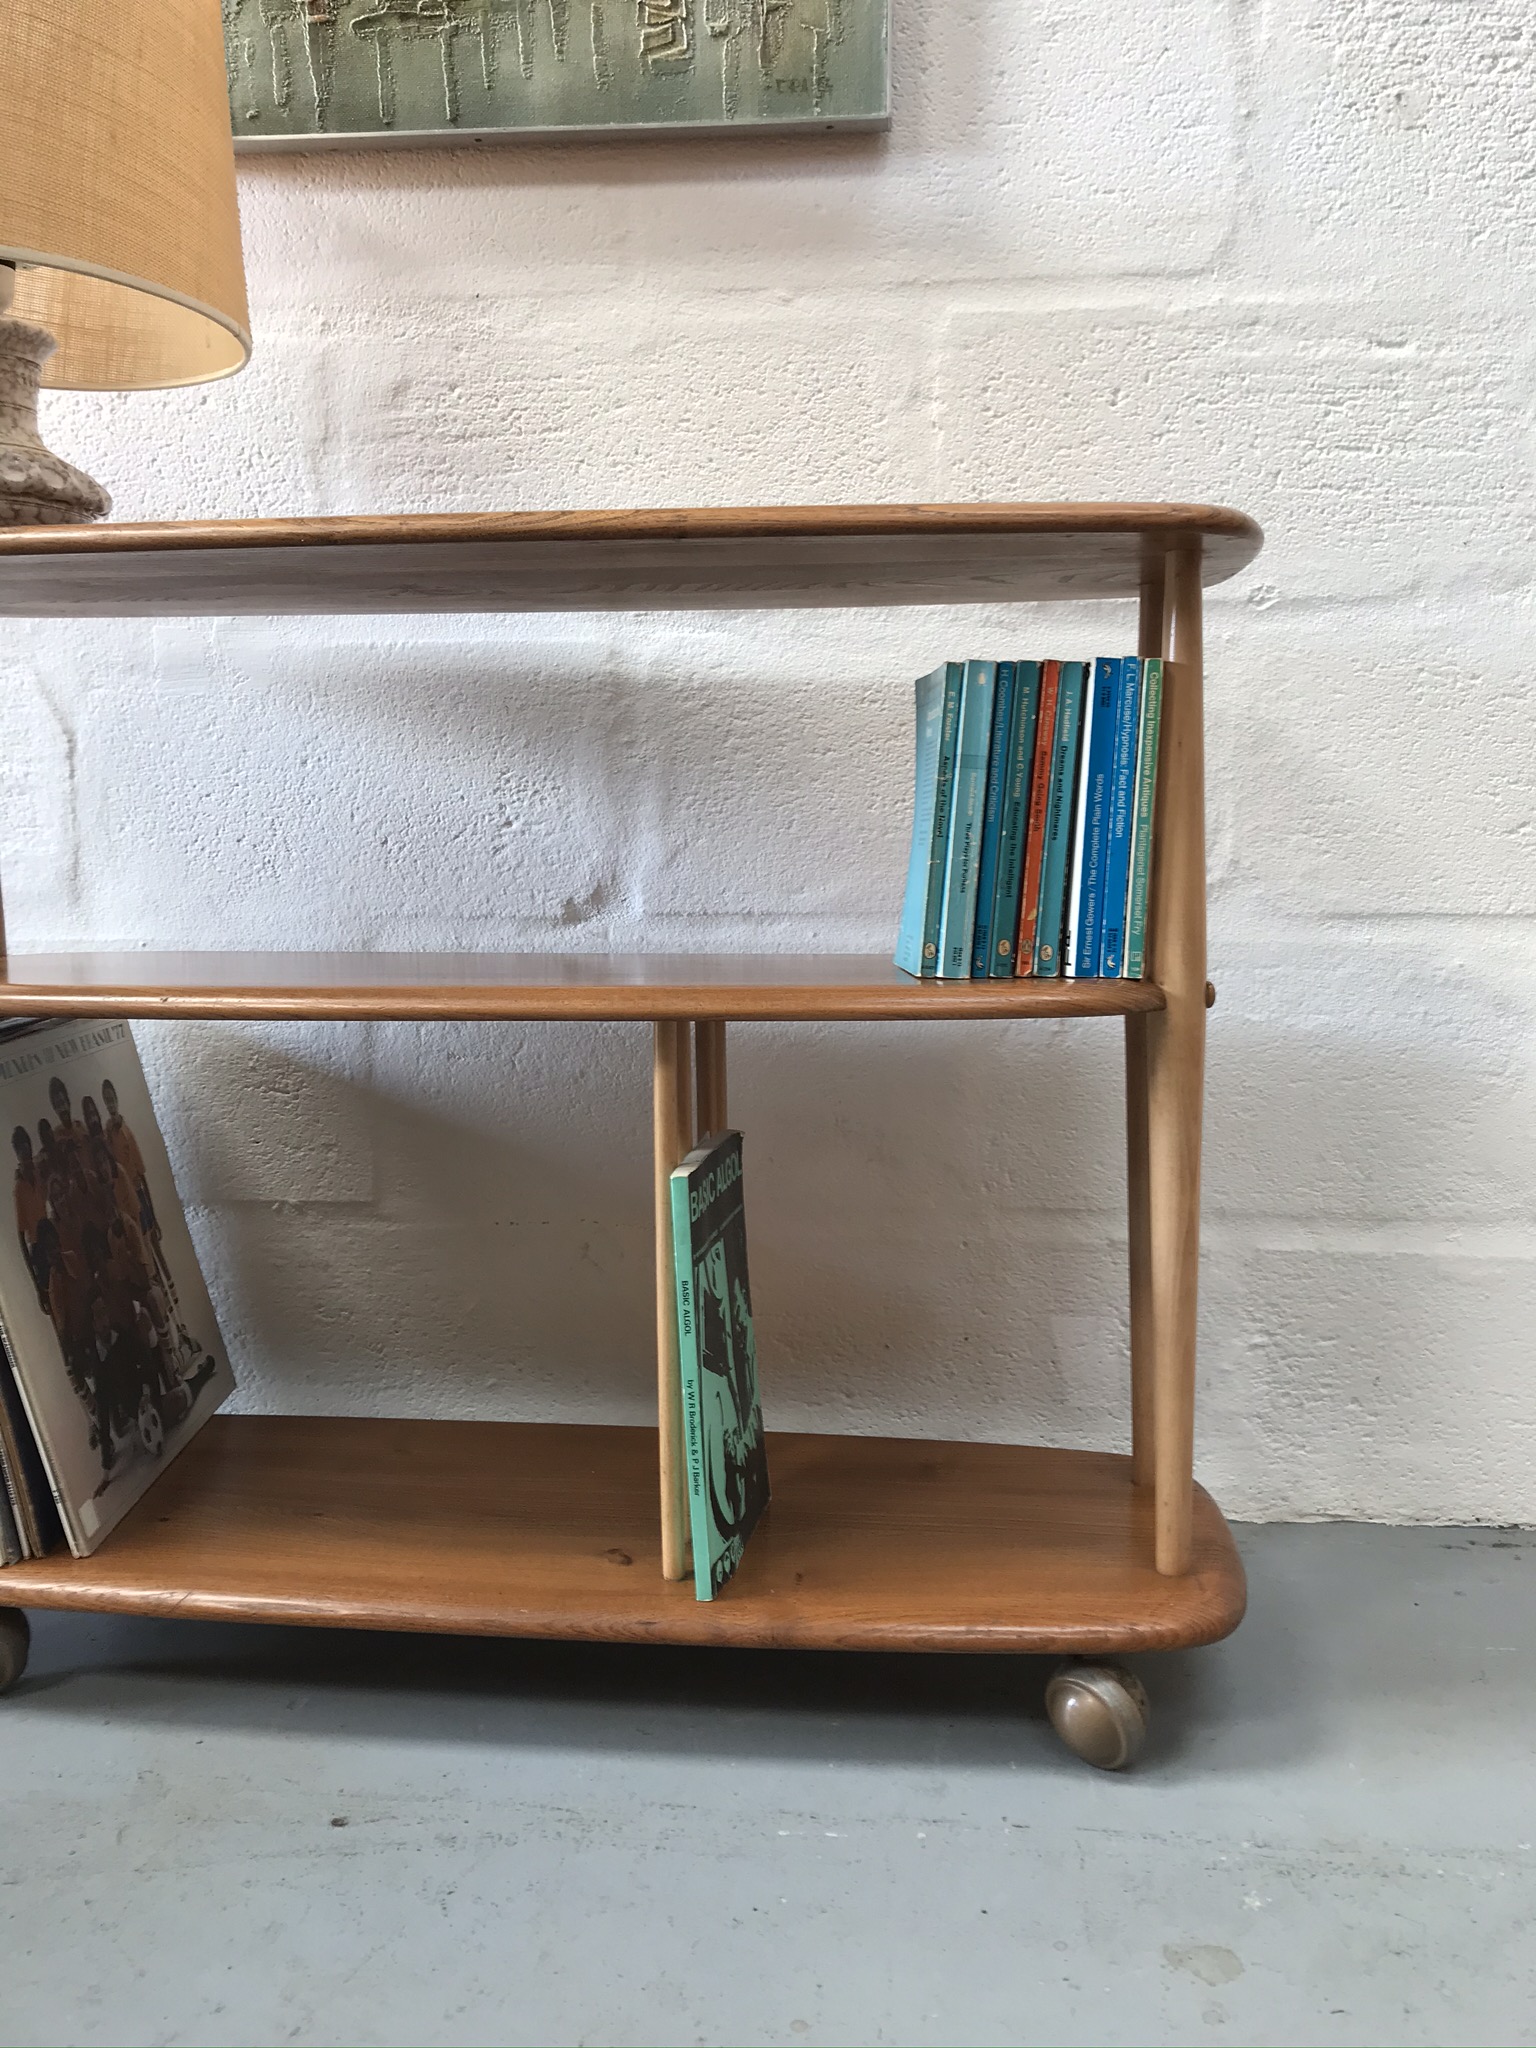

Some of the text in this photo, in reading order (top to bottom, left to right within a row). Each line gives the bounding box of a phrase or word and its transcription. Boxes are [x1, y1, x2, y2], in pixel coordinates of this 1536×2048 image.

[1017, 697, 1029, 743] Hutchinson
[1061, 708, 1072, 742] Hadfield
[1017, 745, 1025, 761] and
[1058, 745, 1068, 776] Dreams
[990, 768, 1001, 784] and
[1056, 778, 1065, 793] and
[1093, 773, 1104, 802] Words
[1118, 769, 1128, 789] Fact
[939, 789, 947, 798] of
[939, 800, 947, 813] the
[987, 785, 999, 823] Criticism
[1035, 783, 1045, 806] Going
[1117, 790, 1127, 807] and
[1131, 672, 1159, 935] Collecting Inexpensive Antiques Plantagenet Somerset Fry
[936, 815, 946, 838] Novel
[1009, 801, 1019, 841] Educating
[1051, 795, 1063, 841] Nightmares
[1092, 804, 1103, 825] Plain
[1115, 809, 1126, 838] Fiction
[1008, 843, 1017, 856] the
[1089, 827, 1101, 867] Complete
[1005, 858, 1016, 898] Intelligent
[1087, 869, 1098, 886] The
[1085, 893, 1096, 926] Gowers
[1082, 927, 1094, 955] Ernest
[1081, 956, 1091, 969] Sir
[690, 1150, 743, 1223] BASIC ALGOL
[681, 1280, 692, 1337] BASIC ALGOL
[686, 1379, 695, 1389] by
[688, 1391, 695, 1401] W
[689, 1411, 698, 1447] Broderick
[693, 1472, 701, 1497] Barker
